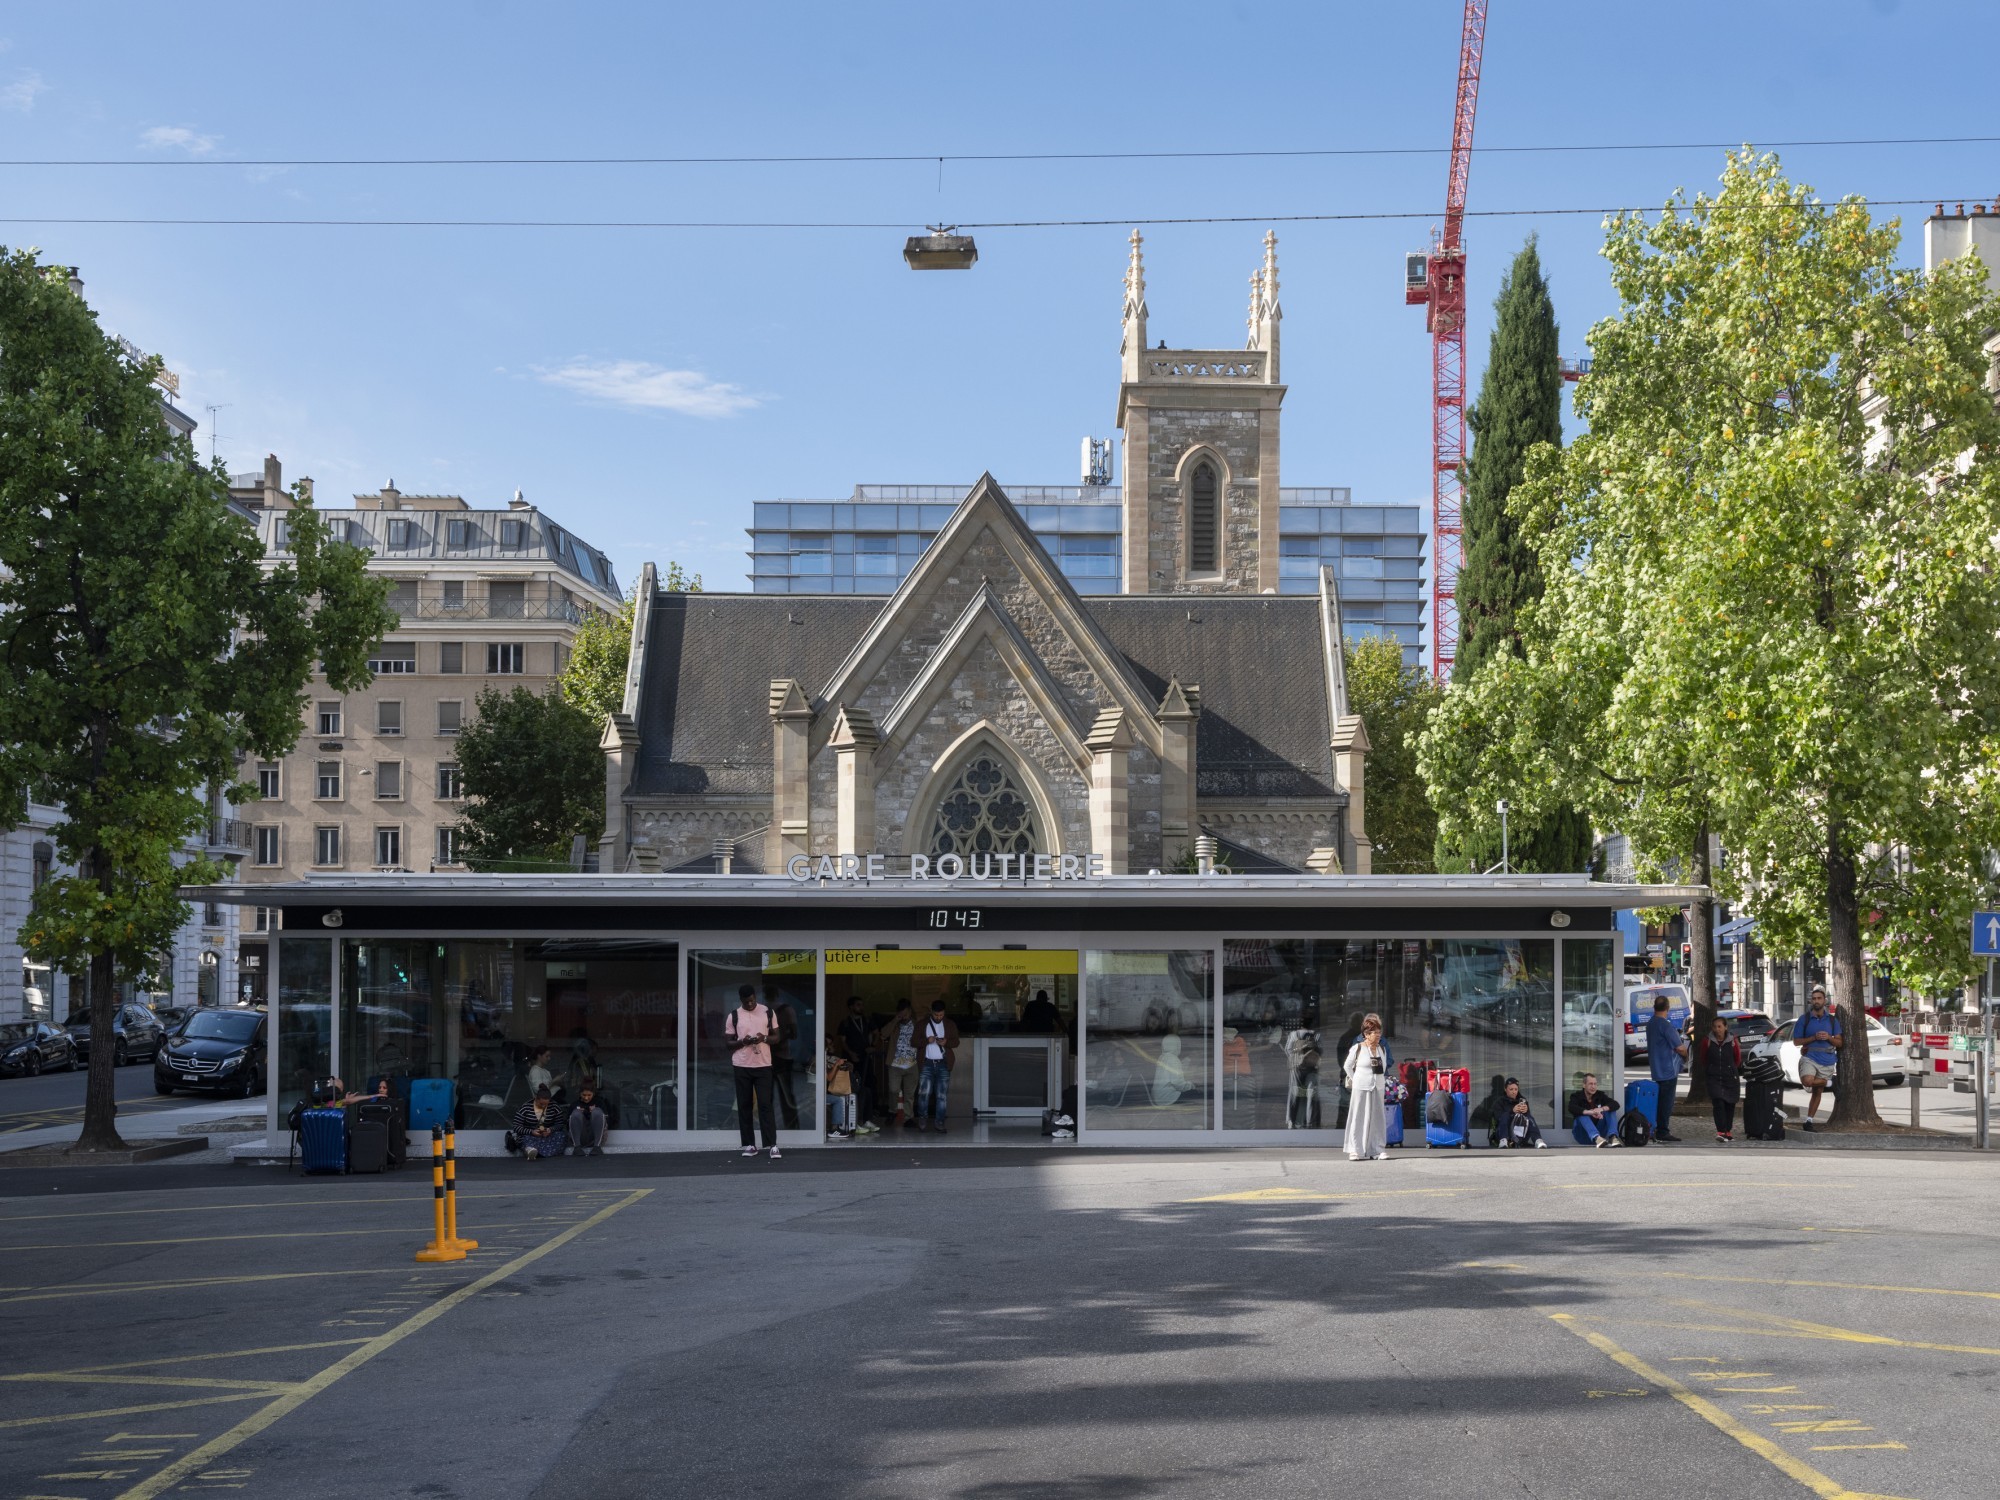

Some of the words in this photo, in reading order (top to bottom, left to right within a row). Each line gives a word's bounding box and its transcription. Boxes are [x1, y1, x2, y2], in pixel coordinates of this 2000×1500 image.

[787, 853, 885, 882] GARE
[911, 853, 1103, 881] ROUTIERE
[930, 910, 948, 928] 10
[955, 910, 980, 928] 43
